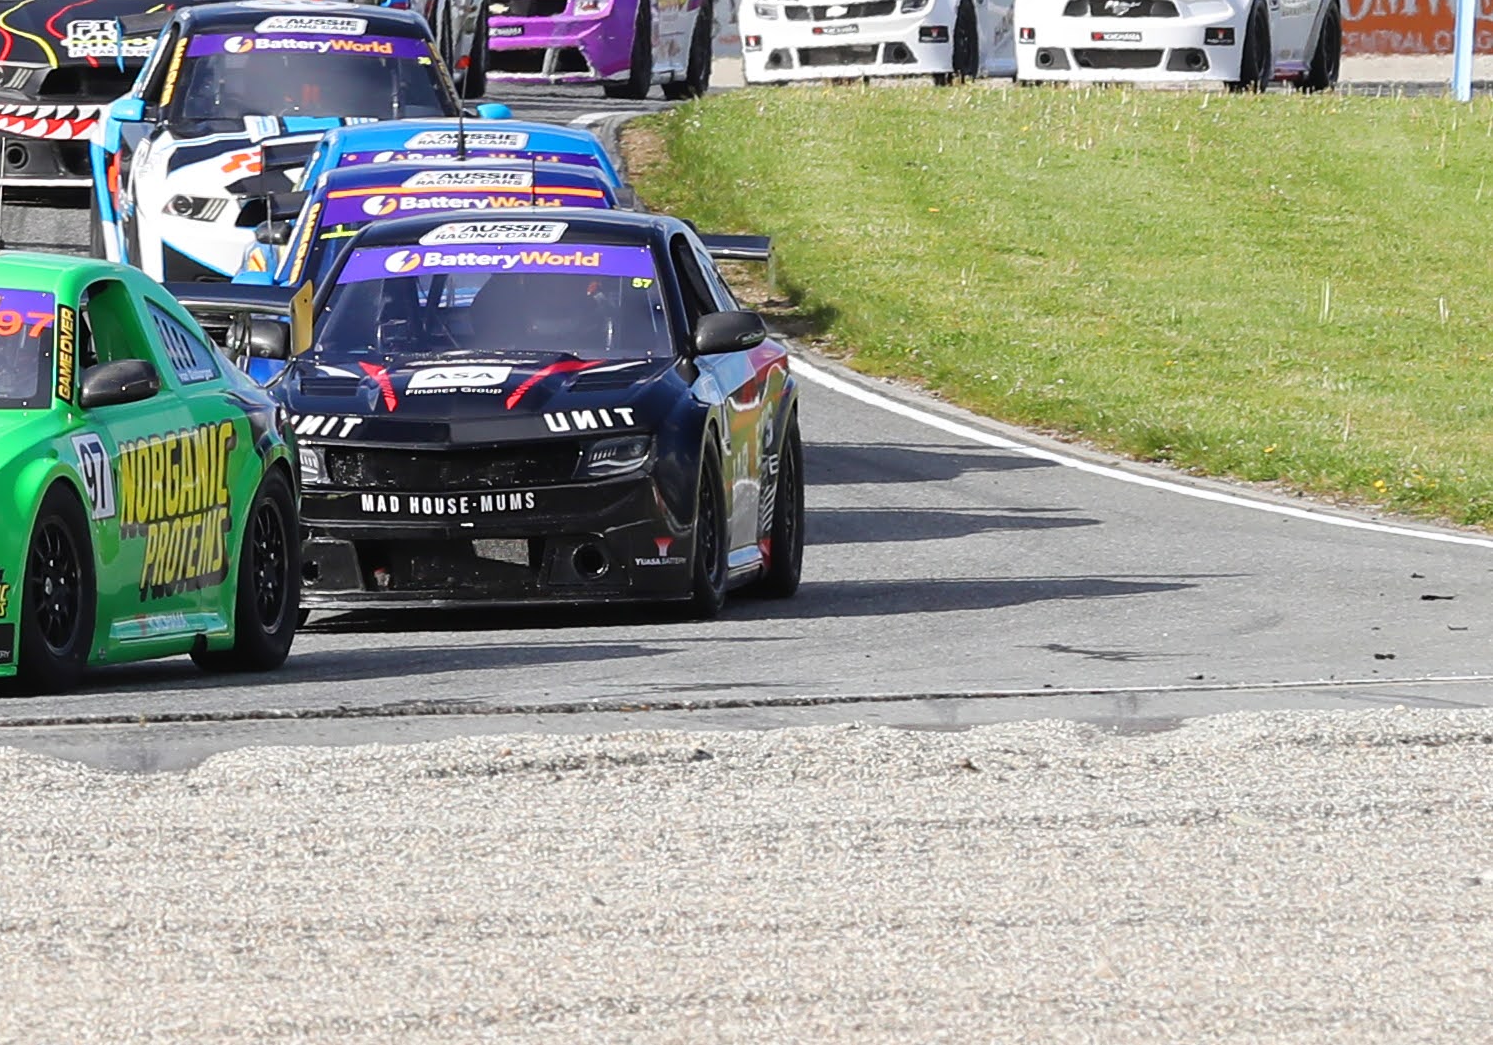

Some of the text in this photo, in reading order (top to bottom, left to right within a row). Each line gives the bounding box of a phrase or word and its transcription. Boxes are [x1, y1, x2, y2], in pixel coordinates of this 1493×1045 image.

[255, 38, 394, 54] BatteryWorld
[459, 224, 555, 232] AUSSIE
[422, 250, 602, 269] BatteryWorld
[630, 277, 653, 289] 57
[425, 372, 495, 380] ASA
[405, 387, 503, 396] Finance Group
[78, 440, 109, 514] 97
[119, 421, 233, 526] NORGANIC
[361, 494, 400, 512] MAD
[138, 507, 229, 590] PROTEINS
